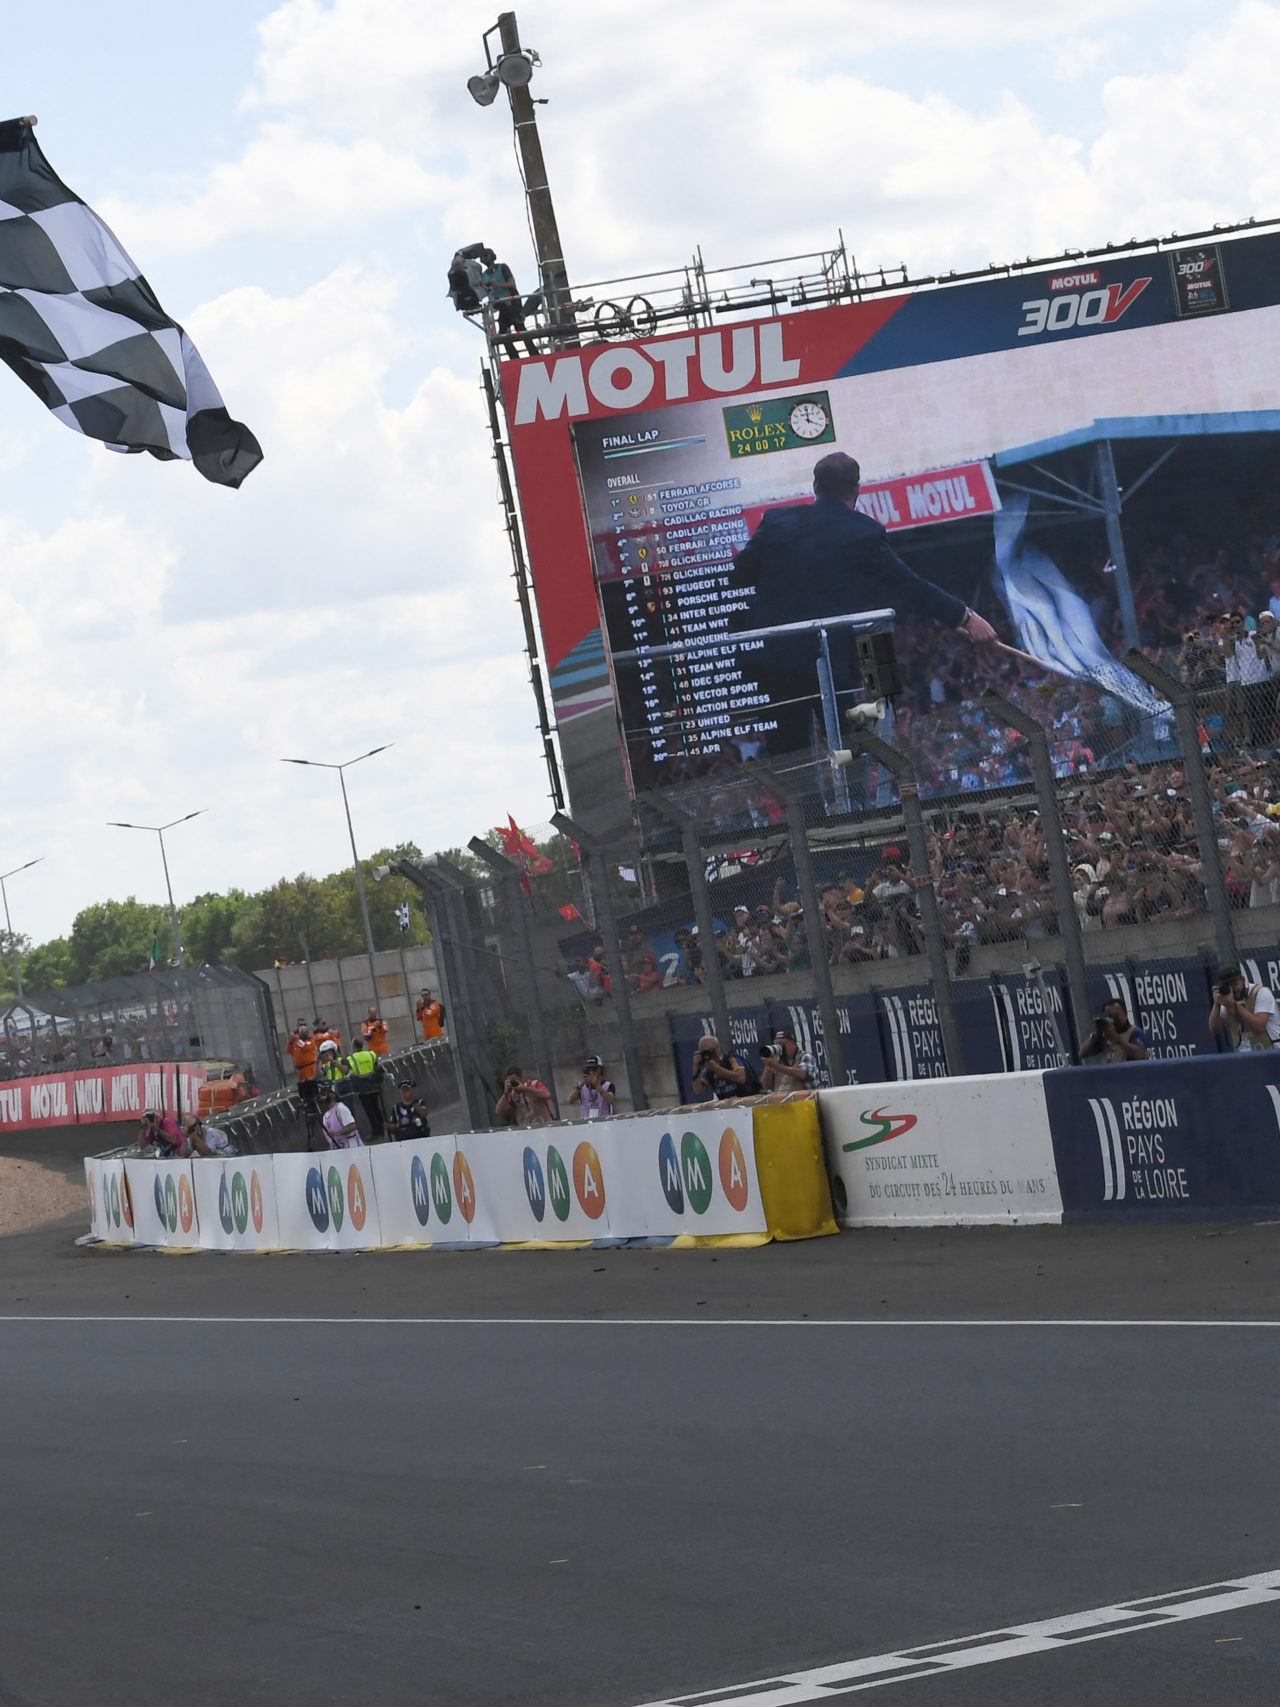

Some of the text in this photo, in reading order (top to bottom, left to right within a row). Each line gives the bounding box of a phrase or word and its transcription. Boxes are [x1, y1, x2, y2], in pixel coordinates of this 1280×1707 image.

[1051, 273, 1098, 290] MOTUL
[1017, 277, 1153, 336] 300V
[514, 322, 801, 425] MOTUL
[602, 429, 659, 448] FINAL LAP
[730, 422, 786, 442] ROLEX
[607, 473, 640, 489] OVERALL
[660, 486, 697, 499] FERRARI
[699, 478, 741, 494] AFCORSE
[662, 501, 695, 513] TOYOTA
[697, 498, 710, 507] GR
[906, 475, 976, 519] MOTUL
[664, 513, 707, 526] CADILLAC
[709, 506, 742, 519] RACING
[666, 526, 709, 539] CADILLAC
[711, 519, 744, 532] RACING
[669, 541, 706, 553] FERRARI
[709, 533, 749, 546] AFCORSE
[671, 549, 733, 567] GLICKENHAUS
[673, 562, 735, 580] GLICKENHAUS
[663, 587, 673, 595] 93
[675, 580, 716, 593] PEUGEOT
[718, 577, 729, 587] TE
[677, 592, 719, 607] PORSCHE
[721, 586, 757, 599] PENSKE
[668, 613, 678, 622] 34
[679, 608, 706, 620] INTER
[709, 602, 750, 616] EUROPOL
[670, 627, 680, 635] 41
[682, 622, 707, 634] TEAM
[709, 618, 729, 629] WRT
[684, 632, 730, 647] DUQUEINE
[687, 647, 718, 661] ALPINE
[721, 644, 737, 655] ELF
[739, 640, 764, 652] TEAM
[676, 667, 686, 675] 31
[688, 662, 713, 674] TEAM
[715, 658, 736, 669] WRT
[691, 676, 712, 687] IDEC
[714, 671, 742, 684] SPORT
[682, 694, 691, 702] 10
[693, 688, 728, 700] VECTOR
[730, 682, 759, 694] SPORT
[696, 701, 727, 714] ACTION
[729, 694, 770, 708] EXPRESS
[686, 721, 696, 729] 23
[697, 715, 730, 727] UNITED
[688, 734, 698, 742] 35
[700, 728, 731, 741] ALPINE
[734, 725, 751, 735] ELF
[753, 721, 778, 732] TEAM
[690, 747, 700, 756] 45
[702, 744, 721, 754] APR
[1134, 970, 1188, 1005] RÉGION
[1022, 1020, 1055, 1049] PAYS
[1141, 1009, 1177, 1040] PAYS
[31, 1082, 68, 1119] MOTUL
[1122, 1096, 1178, 1130] RÉGION
[1126, 1134, 1165, 1165] PAYS
[865, 1154, 940, 1171] SYNDICAT MIXTE
[869, 1184, 881, 1198] DU
[884, 1183, 921, 1198] CIRCUIT
[923, 1182, 941, 1197] DES
[941, 1172, 957, 1196] 24
[960, 1180, 997, 1196] HEURES
[999, 1180, 1014, 1194] DU
[1132, 1168, 1189, 1199] DE LA LOIRE
